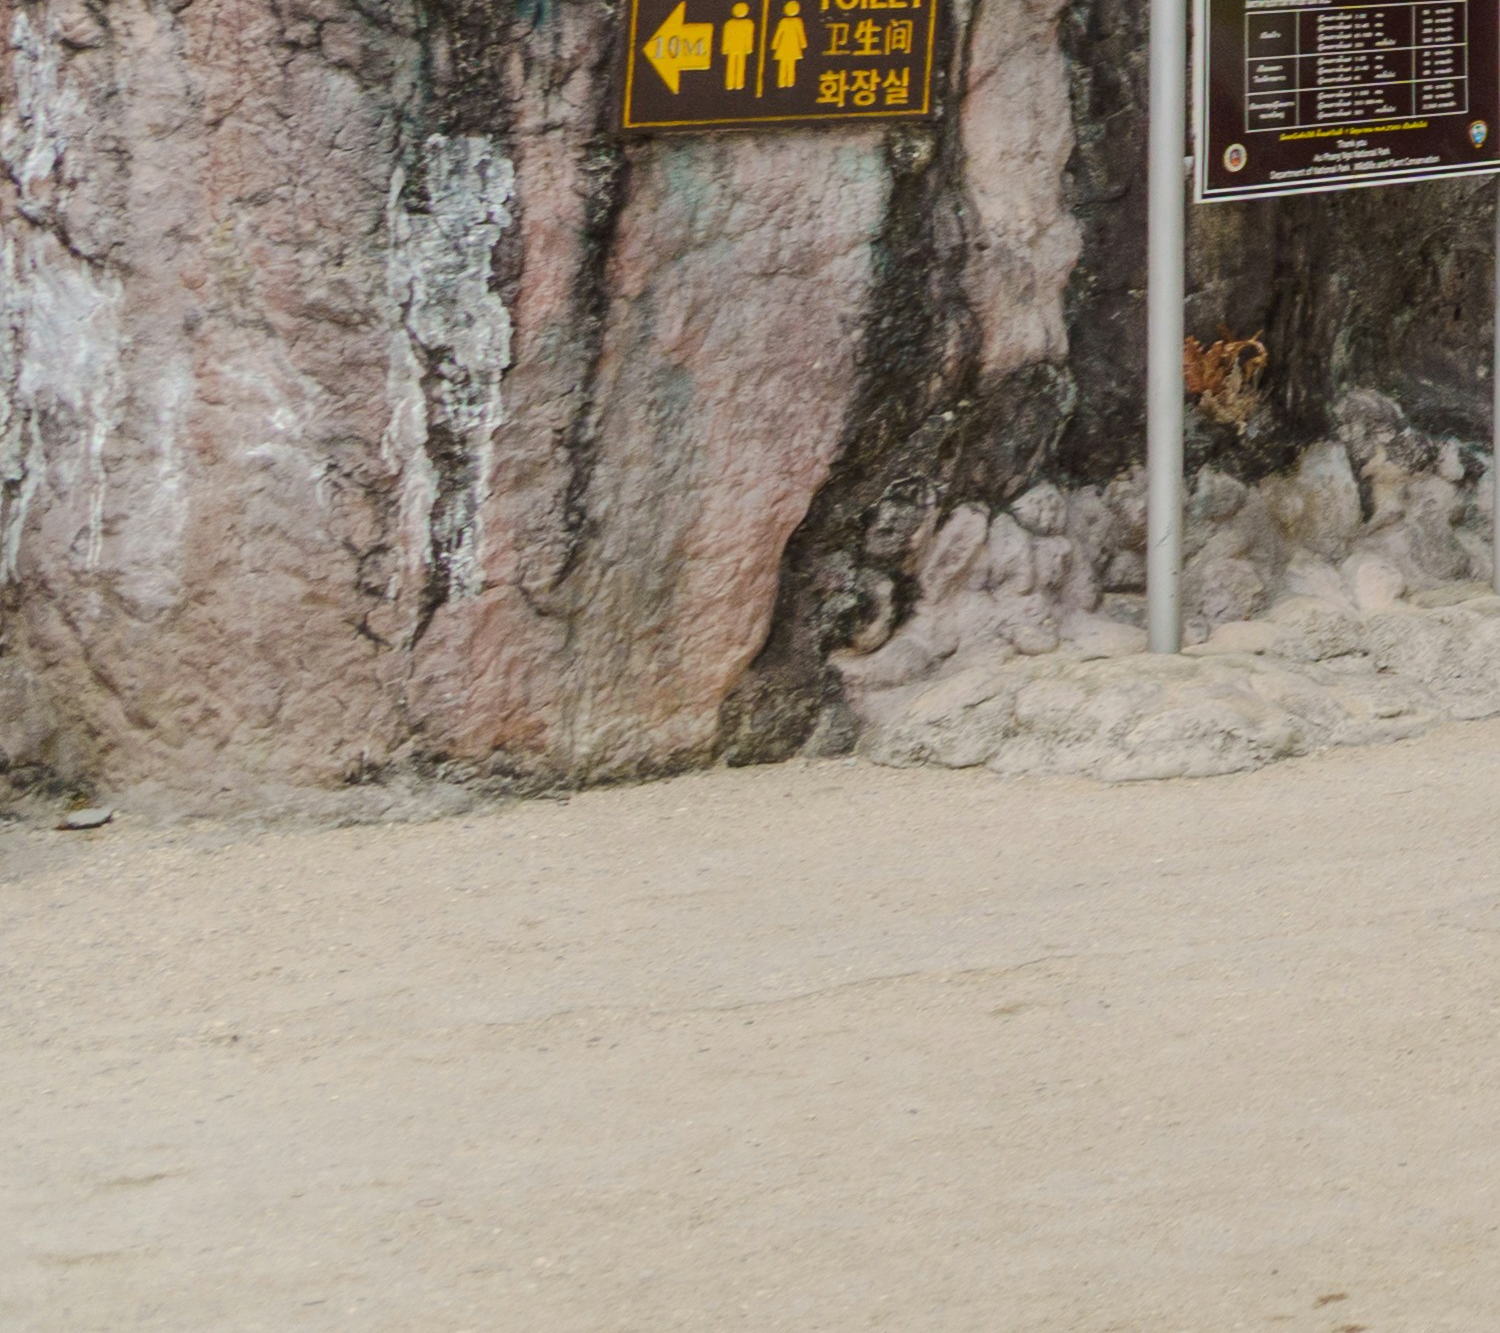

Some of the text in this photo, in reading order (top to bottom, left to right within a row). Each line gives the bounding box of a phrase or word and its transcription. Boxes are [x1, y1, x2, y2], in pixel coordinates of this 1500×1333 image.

[823, 18, 914, 57] 卫生间
[815, 67, 910, 108] 화장실
